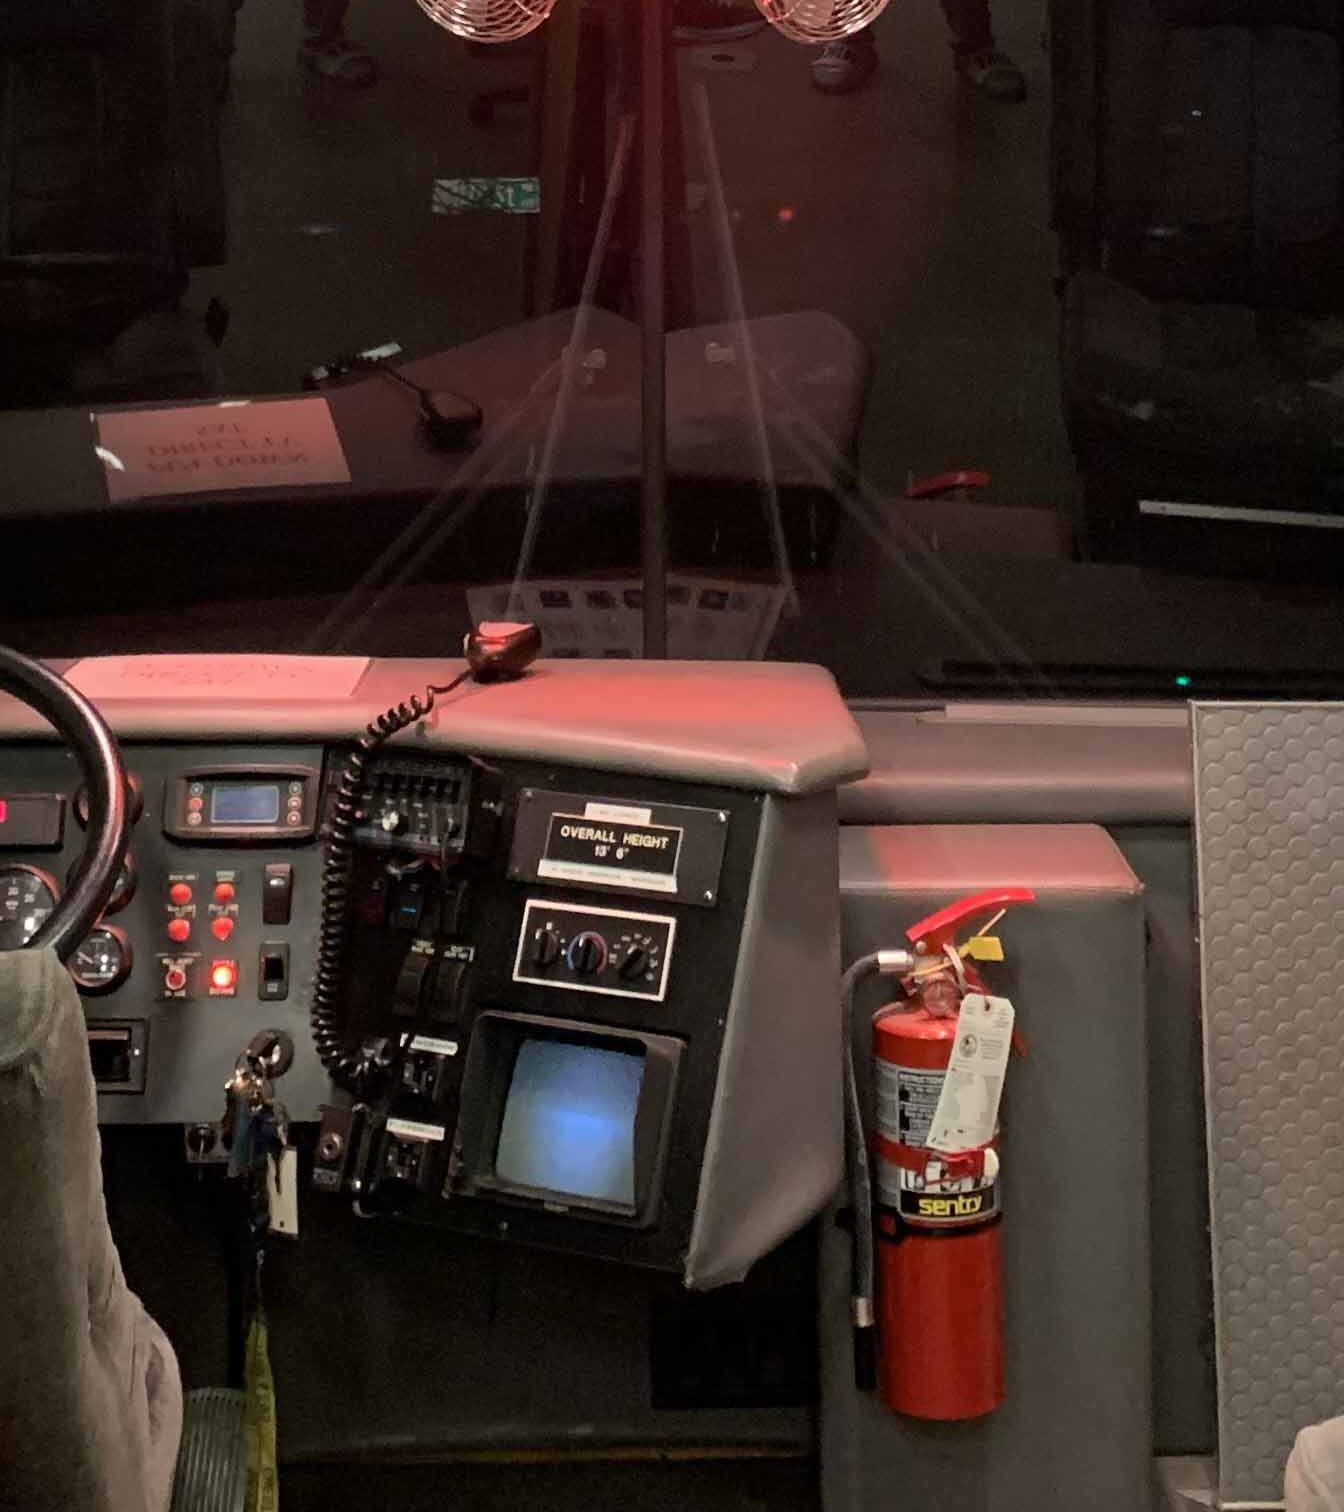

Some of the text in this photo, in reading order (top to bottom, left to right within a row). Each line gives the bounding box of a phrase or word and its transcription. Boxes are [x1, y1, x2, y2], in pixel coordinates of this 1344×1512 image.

[560, 824, 670, 850] OVERALL HEIGHT
[919, 1194, 982, 1216] sentry
